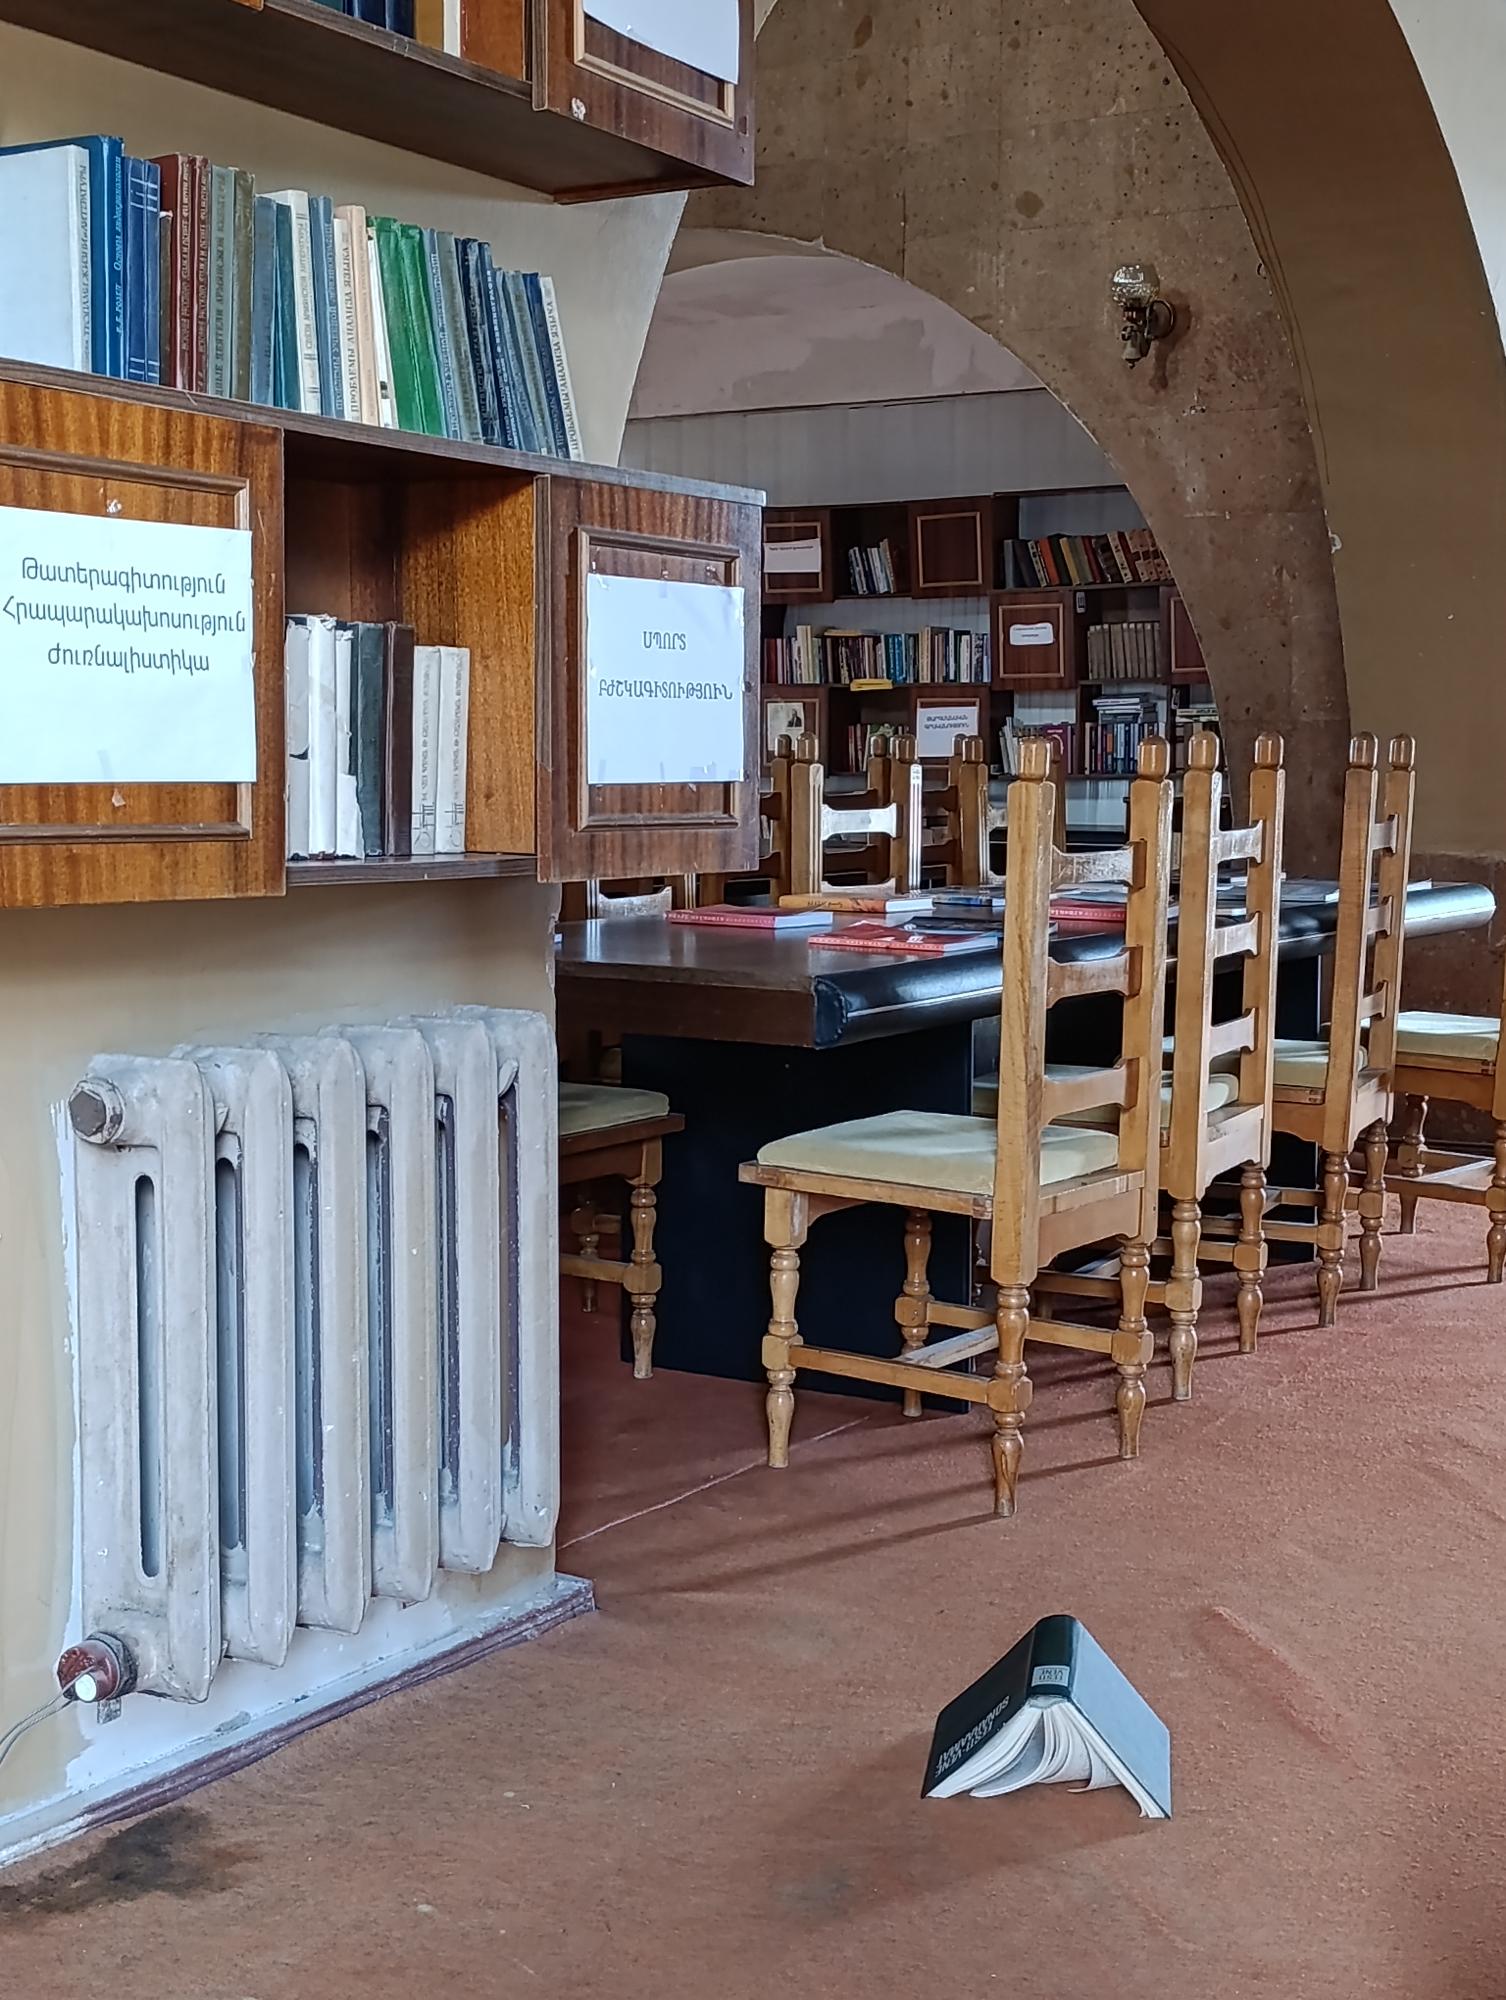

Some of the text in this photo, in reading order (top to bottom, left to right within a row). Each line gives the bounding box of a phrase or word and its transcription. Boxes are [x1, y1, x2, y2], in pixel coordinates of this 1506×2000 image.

[343, 246, 359, 412] ПРОБЛЕМЫ АНАЛИЗА ЯЗЫКА
[545, 300, 579, 450] ПРОБЛЕМЫ АНАЛИЗА ЯЗЫКА
[22, 556, 226, 597] Թատերագիտություն
[2, 595, 246, 636] Հրապարակախոսություն
[642, 630, 687, 650] ՍՊՈՐՏ
[599, 678, 733, 701] ԲԺՇԿԱԳԻՏՈՒԹՅՈՒՆ
